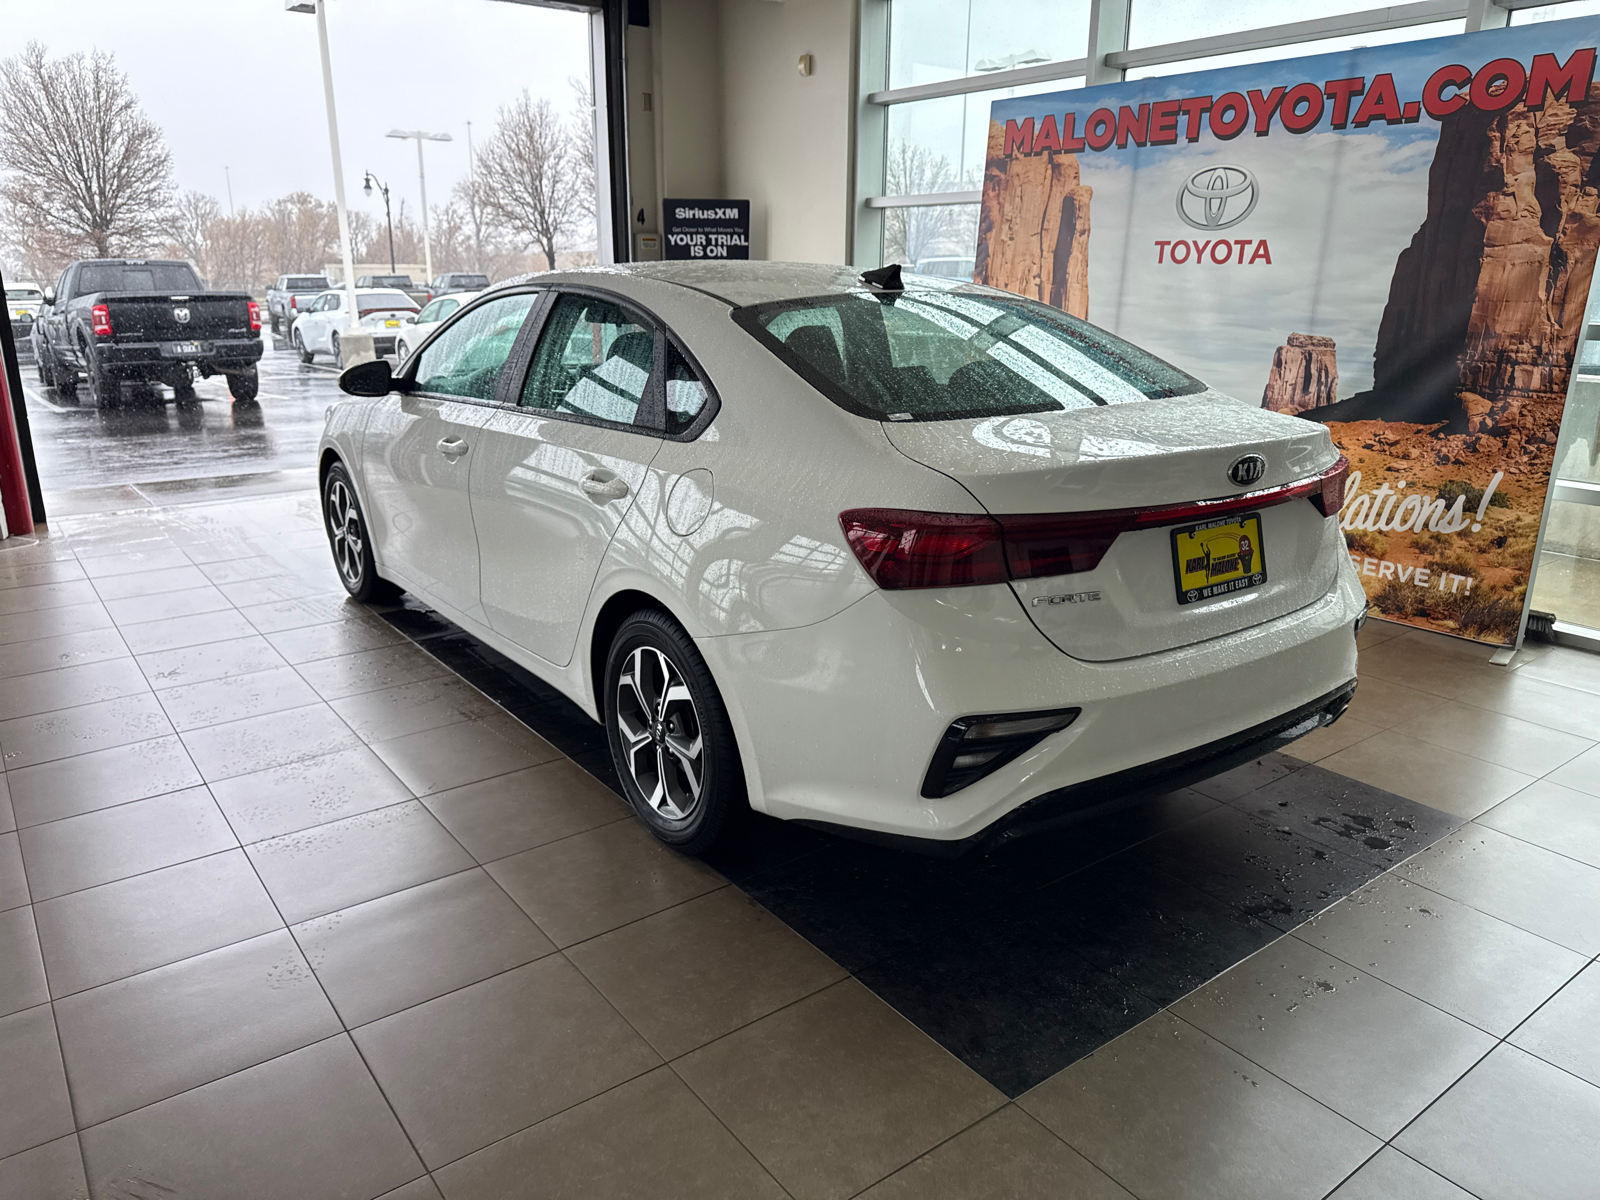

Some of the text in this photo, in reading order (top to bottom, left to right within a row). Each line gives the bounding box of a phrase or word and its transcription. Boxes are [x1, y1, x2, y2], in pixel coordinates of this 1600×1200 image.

[1003, 47, 1598, 157] MALONETOYOTA.COM
[637, 208, 645, 225] 4
[675, 207, 739, 219] SiriusXM
[668, 234, 706, 246] YOUR
[708, 234, 749, 246] TRIAL
[690, 246, 728, 257] IS ON
[1154, 238, 1272, 266] TOYOTA
[1236, 460, 1262, 481] KIA
[1241, 540, 1250, 551] 32
[1185, 556, 1207, 575] KARL
[1210, 558, 1240, 578] MALONE
[1202, 579, 1249, 598] WE MAKE IT EASY
[1439, 572, 1473, 596] IT!
[1031, 590, 1101, 608] FORTE
